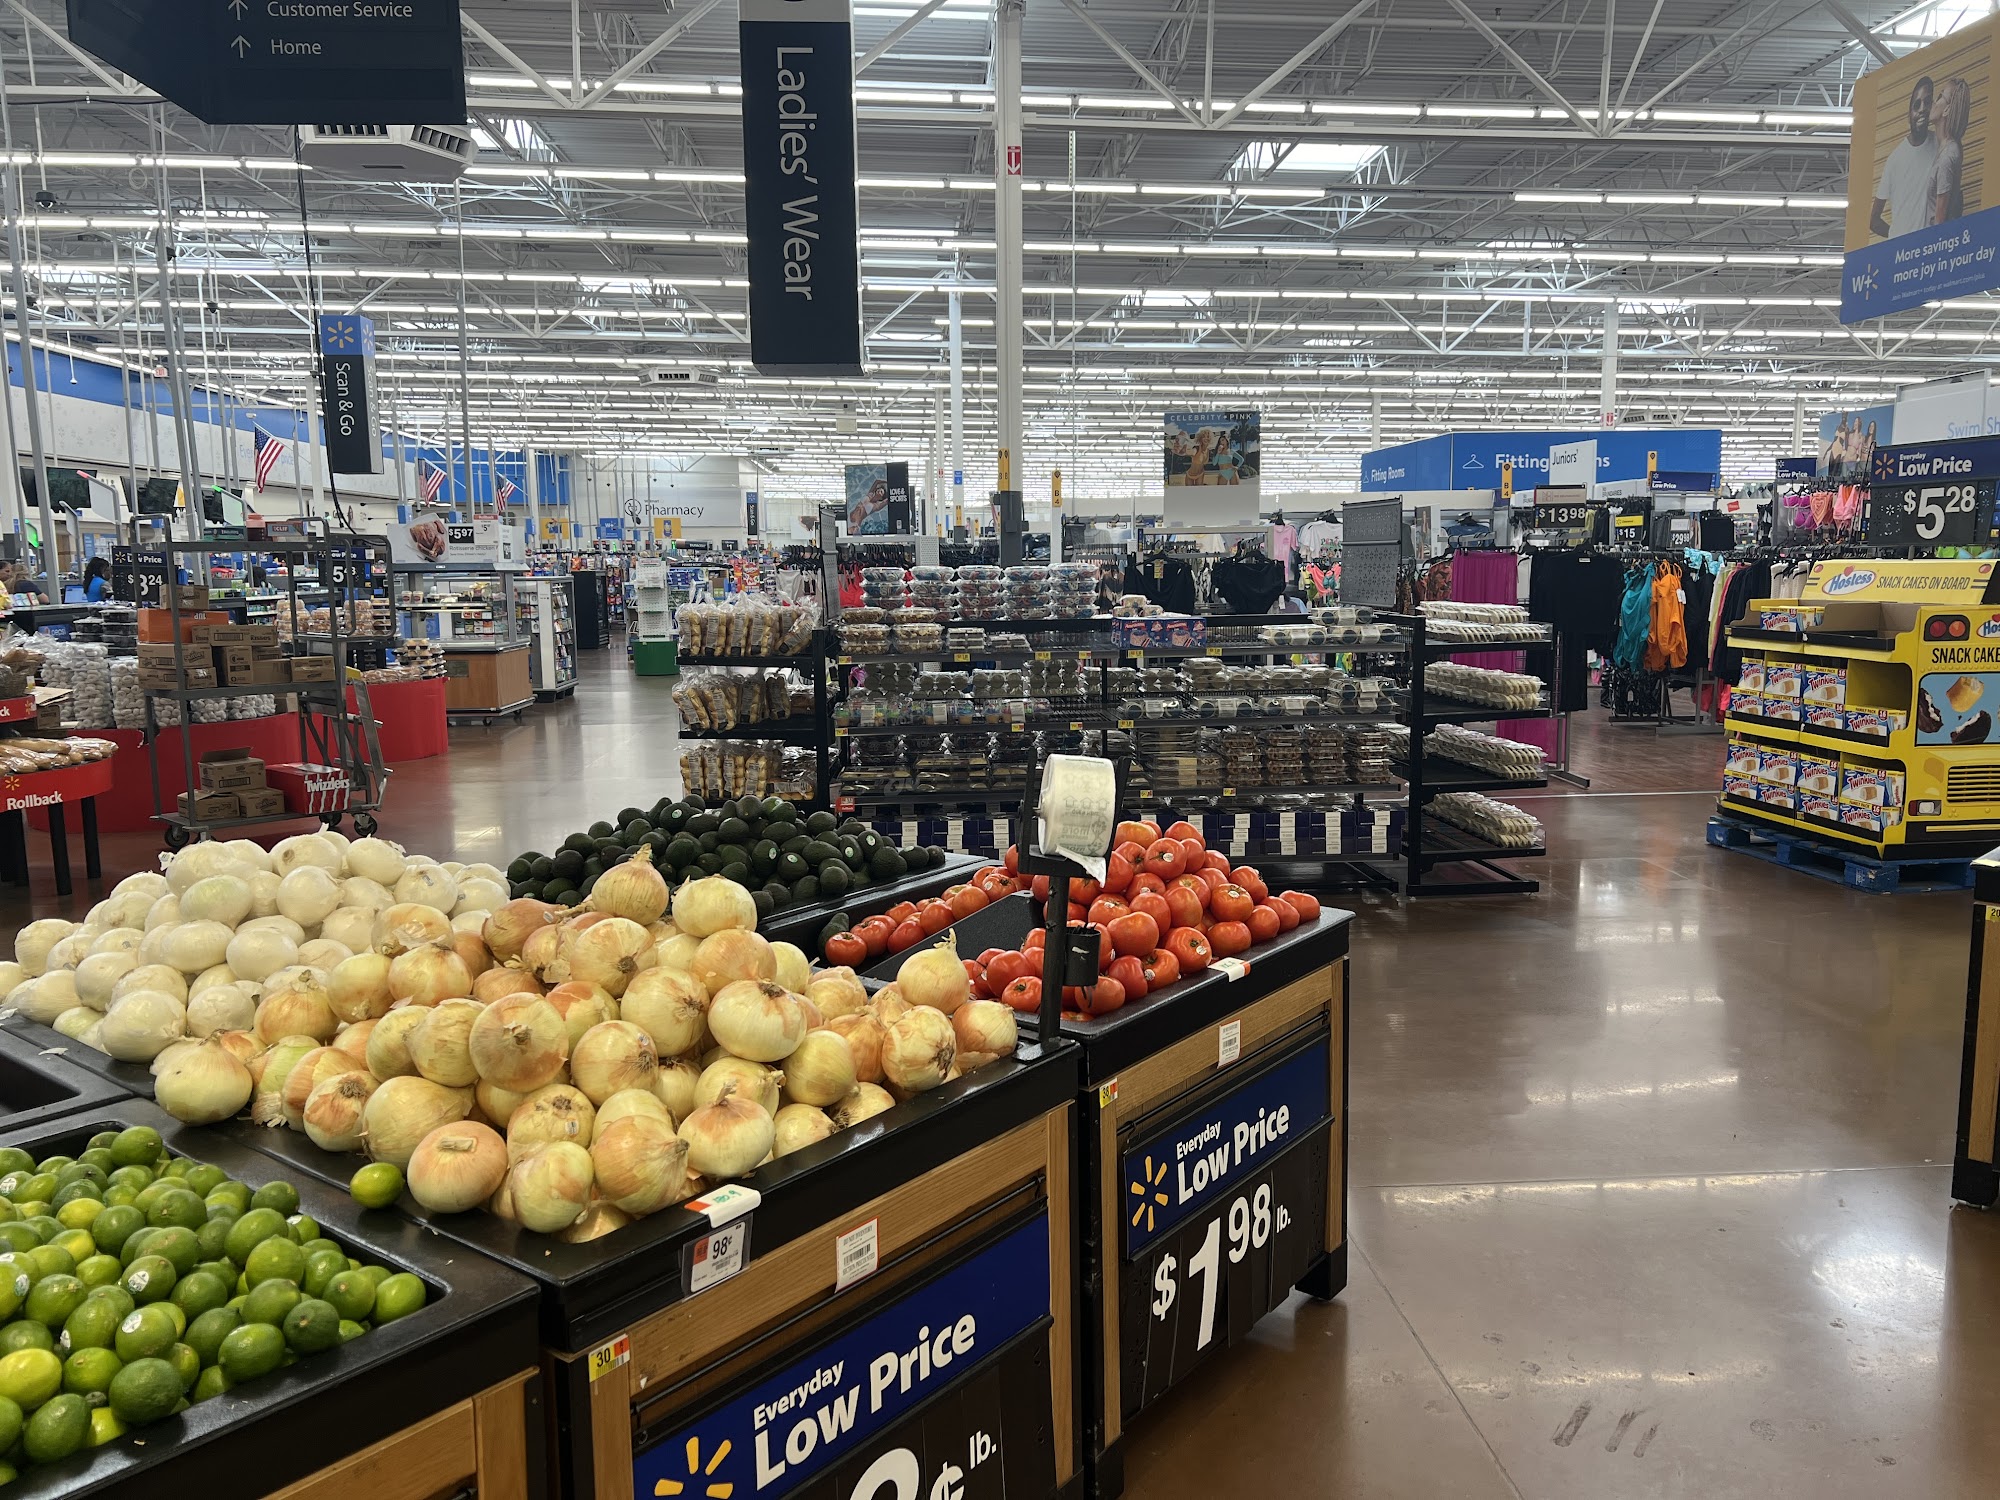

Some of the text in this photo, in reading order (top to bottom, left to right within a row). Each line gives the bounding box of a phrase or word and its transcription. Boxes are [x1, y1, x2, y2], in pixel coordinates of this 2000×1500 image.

[267, 1, 413, 18] Customer Service
[270, 39, 322, 55] Home
[777, 46, 820, 301] Ladies' Wear
[1895, 229, 1971, 264] More savings &
[1893, 245, 1996, 283] more joy in your day
[335, 362, 355, 436] Scan & Go
[1170, 414, 1221, 422] CELEBRITY
[1947, 420, 1980, 439] Swim
[1496, 452, 1550, 472] Fitting
[1552, 449, 1580, 466] Juniors'
[1900, 452, 1927, 461] Everyday
[1371, 466, 1405, 483] Fitting Rooms
[1898, 457, 1973, 477] Low Price
[889, 488, 901, 496] LOVE
[645, 503, 704, 518] Pharmacy
[1618, 528, 1636, 539] $15
[143, 555, 162, 564] Price
[1829, 572, 1971, 594] Hostess SNACK CAKES ON BOARD
[1763, 615, 1789, 630] Twinkies
[1931, 648, 1971, 664] SNACK
[1769, 670, 1793, 686] Twinkies
[1809, 675, 1836, 690] Twinkies
[1733, 698, 1758, 711] Twinkies
[1767, 702, 1792, 716] Twinkies
[1808, 710, 1835, 724] Twinkies
[1849, 716, 1877, 731] Twinkies
[1732, 750, 1756, 763] Twinkies
[1764, 757, 1789, 771] Twinkies
[1803, 766, 1828, 779] Twinkies
[304, 777, 350, 793] Twizzlers
[1726, 782, 1749, 793] Twinkies
[1848, 776, 1876, 789] Twinkies
[6, 791, 63, 811] Rollback
[1762, 790, 1787, 802] Twinkies
[1803, 800, 1829, 813] Twinkies
[1843, 811, 1870, 824] Twinkies
[1176, 1121, 1222, 1161] Everyday
[1177, 1104, 1290, 1206] Low Price
[1276, 1204, 1291, 1234] lb.
[712, 1235, 733, 1260] 98¢
[596, 1347, 611, 1368] 30
[753, 1360, 844, 1431] Everyday
[754, 1314, 976, 1492] Low Price
[969, 1430, 997, 1470] lb.
